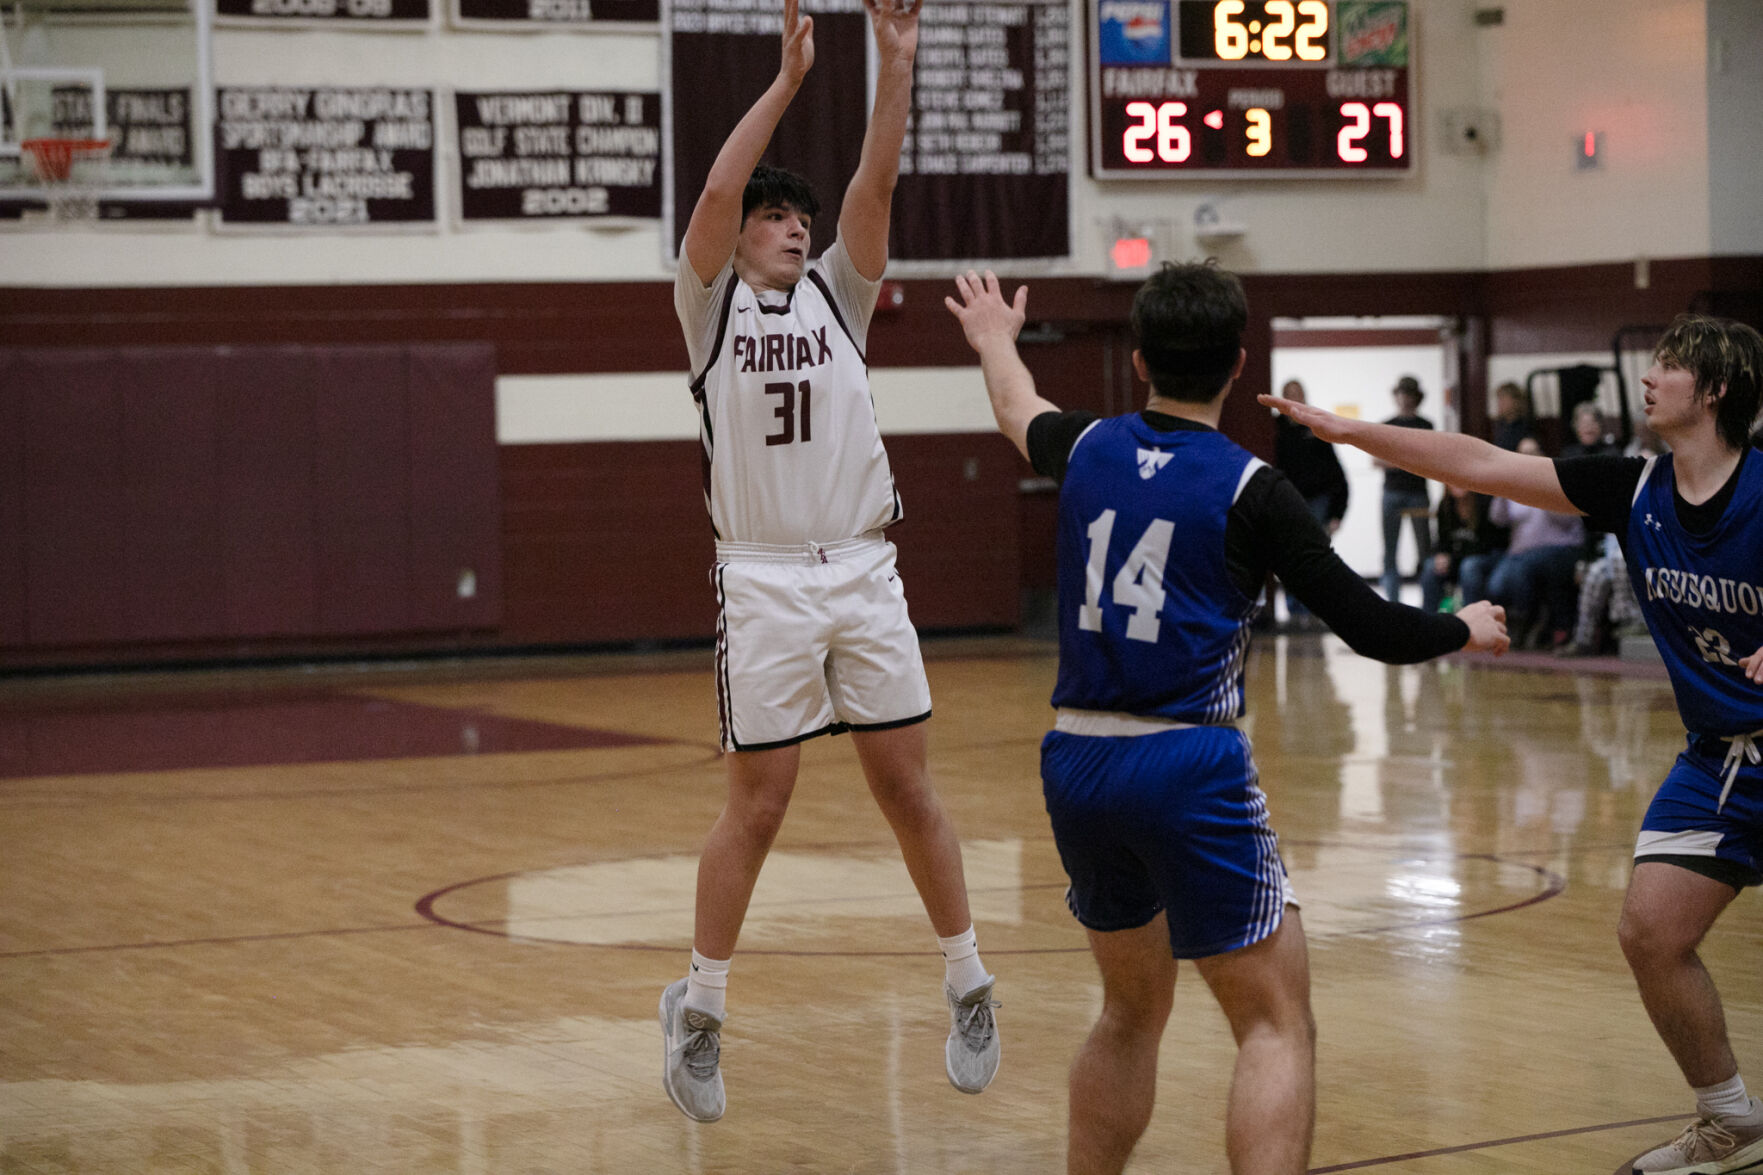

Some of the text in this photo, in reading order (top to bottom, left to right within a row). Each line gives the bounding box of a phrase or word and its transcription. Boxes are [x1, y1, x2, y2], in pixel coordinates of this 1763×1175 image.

[1101, 1, 1164, 23] PEPSI
[1214, 0, 1328, 61] 6:22
[1102, 68, 1199, 98] FAIRFAX
[1227, 87, 1285, 109] PERIOD
[1326, 68, 1399, 98] GUEST
[476, 94, 571, 125] VERMONT
[221, 120, 432, 149] SPORTSMANSHIP AWARD
[461, 126, 659, 157] GOLF STATE CHAMPION
[1123, 102, 1191, 163] 26
[1245, 107, 1272, 157] 3
[1337, 102, 1404, 163] 27
[242, 172, 414, 199] BOYS LACROSSE
[467, 157, 571, 189] JONATHAN
[289, 198, 369, 224] 2021
[521, 187, 610, 215] 2002
[764, 379, 811, 446] 31
[1078, 508, 1175, 644] 14
